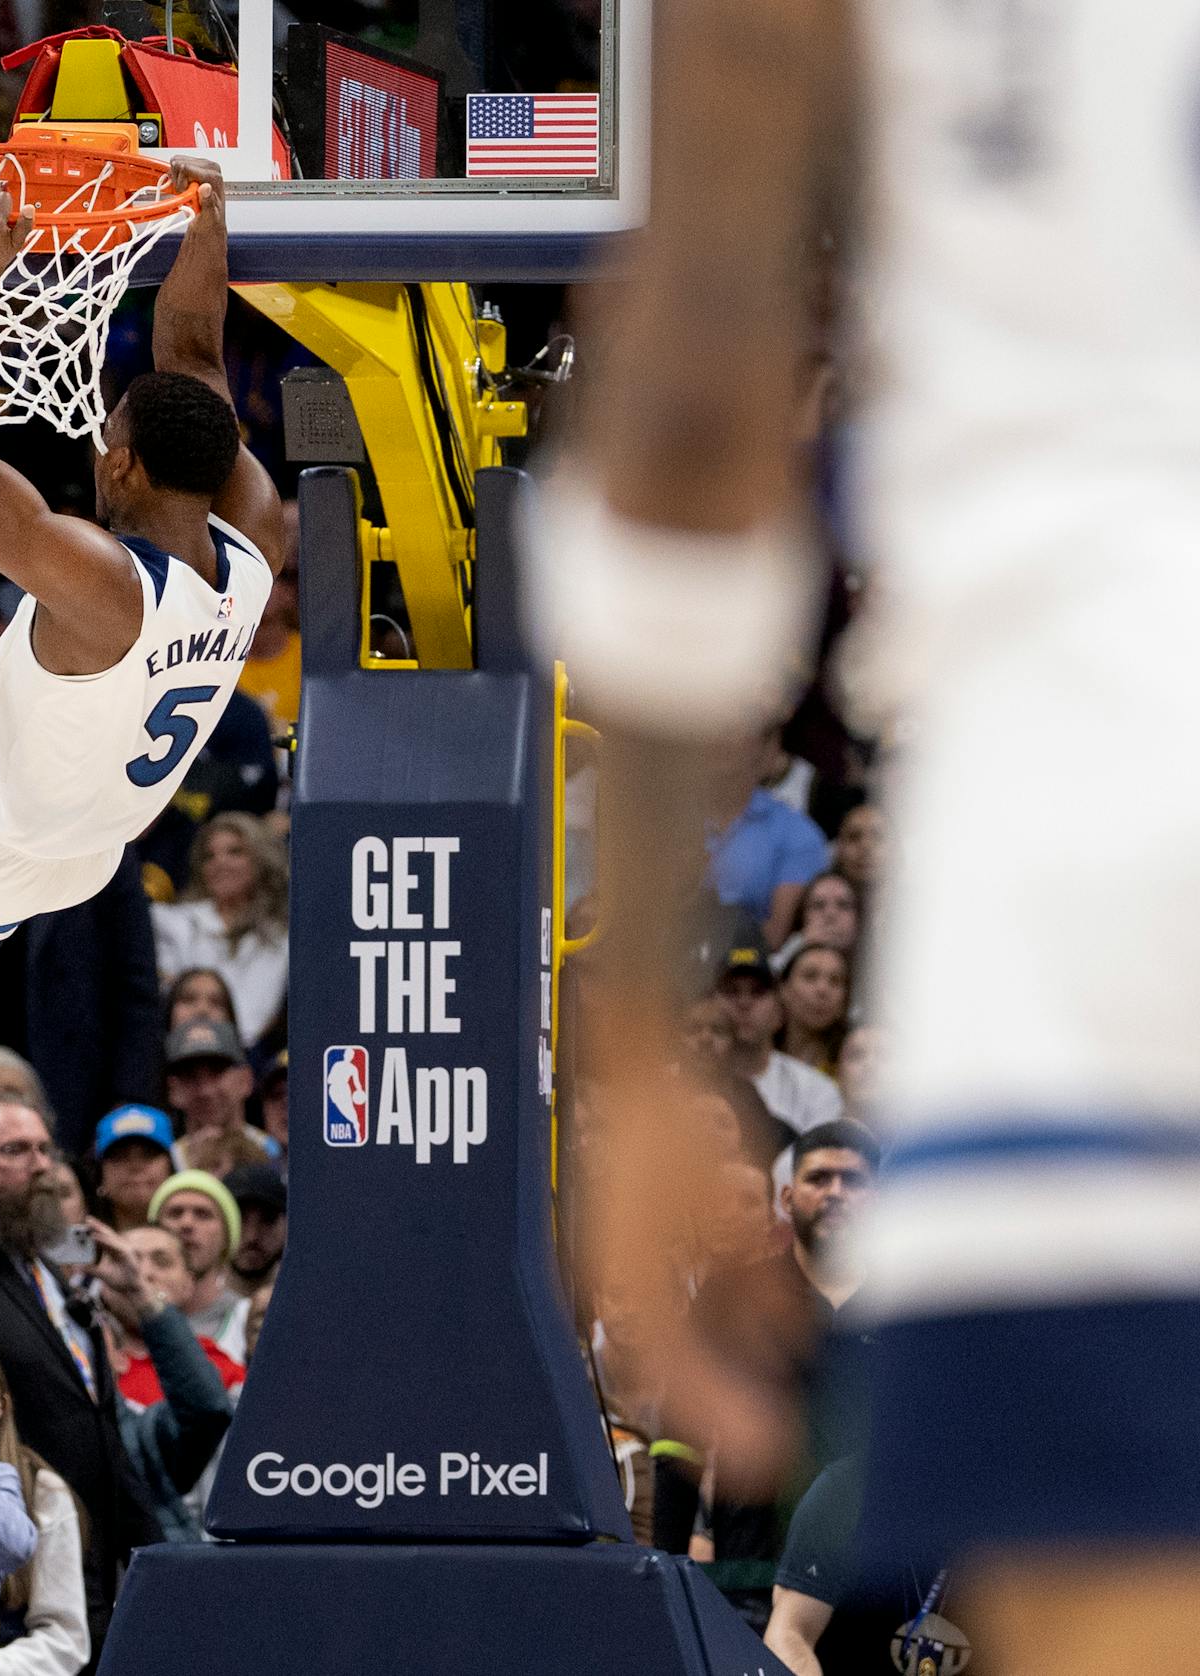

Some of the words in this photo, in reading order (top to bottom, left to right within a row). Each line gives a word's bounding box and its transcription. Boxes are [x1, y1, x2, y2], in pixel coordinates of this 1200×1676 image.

[126, 685, 221, 788] 5
[351, 836, 460, 930] GET
[350, 941, 461, 1033] THE
[330, 1123, 352, 1140] NBA
[376, 1047, 488, 1164] App
[246, 1451, 427, 1509] Google
[440, 1452, 548, 1496] Pixel
